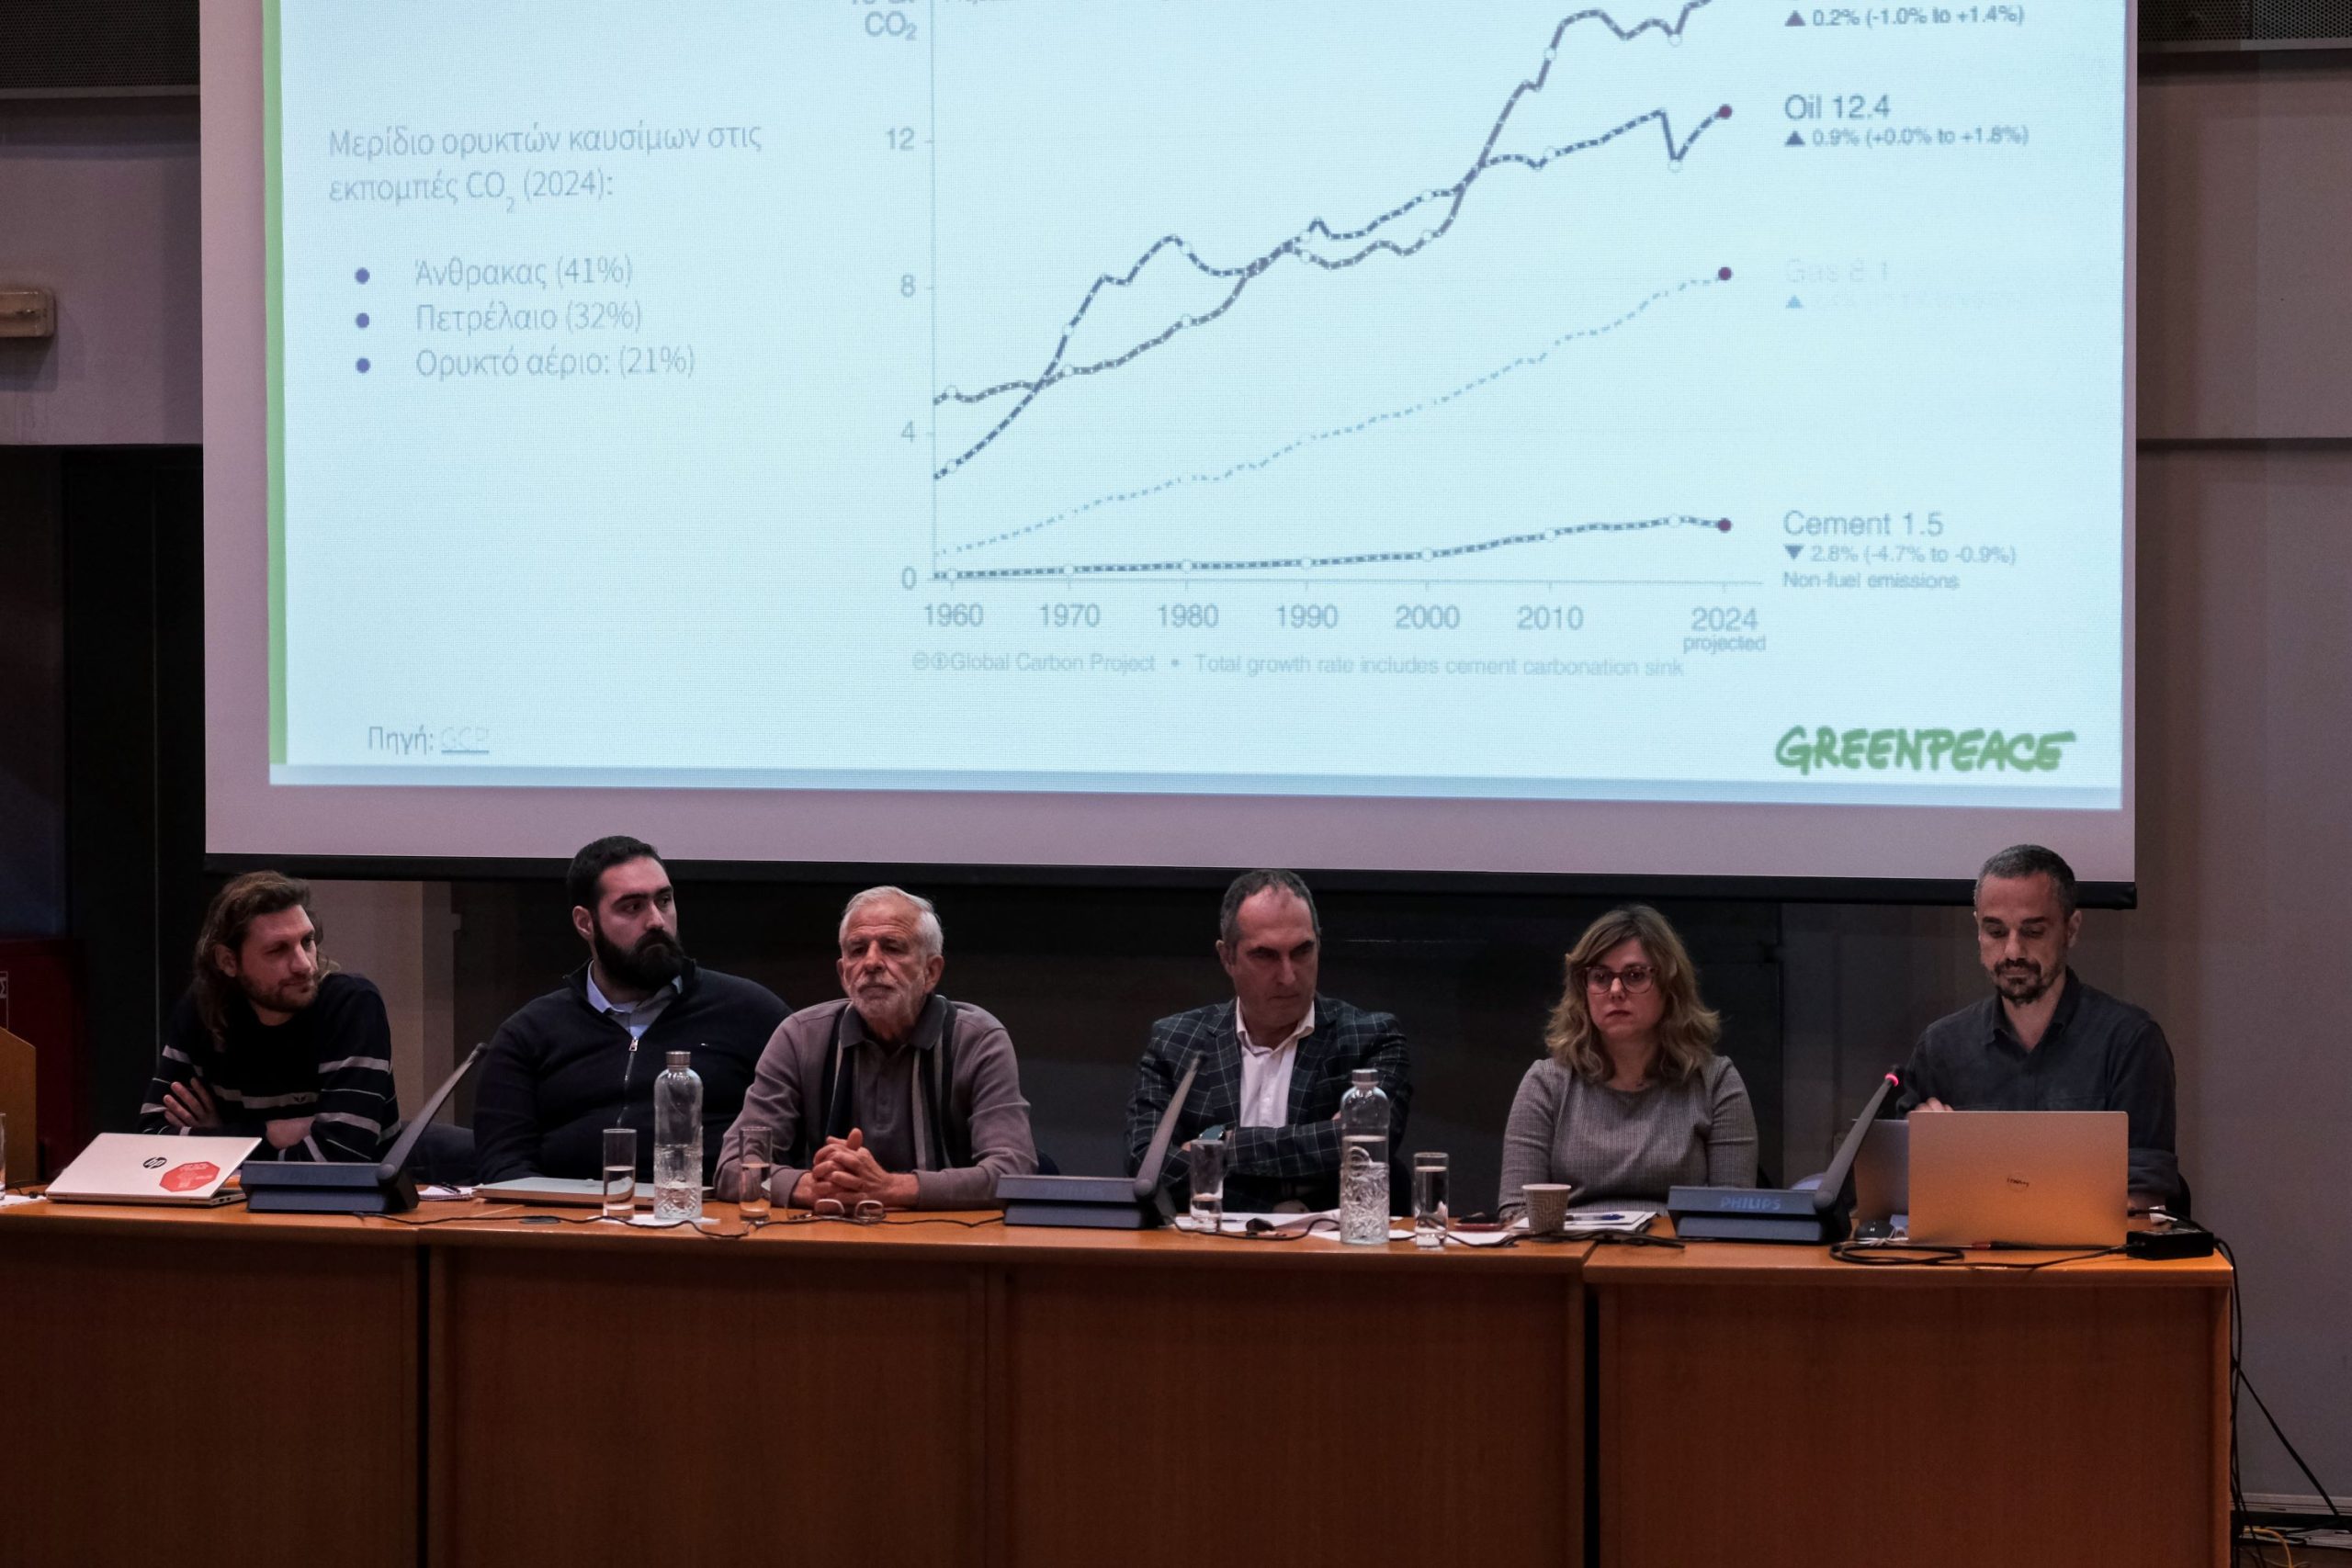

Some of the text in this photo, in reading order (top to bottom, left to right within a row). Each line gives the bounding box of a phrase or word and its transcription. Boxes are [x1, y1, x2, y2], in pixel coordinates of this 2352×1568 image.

[1813, 5, 2025, 28] 0.2% (-1.0% to +1.4%)
[1784, 94, 1891, 120] Oil 12.4
[329, 120, 763, 158] Μερίδιο ορυκτών καυσίμων στις
[886, 127, 915, 151] 12
[1866, 127, 1932, 148] (+0.0%
[1938, 127, 1955, 144] to
[329, 173, 458, 205] εκπομπές
[524, 169, 614, 203] (2024):
[415, 254, 633, 291] Άνθρακας (41%)
[900, 274, 916, 298] 8
[415, 300, 641, 336] Πετρέλαιο (32%)
[415, 344, 695, 381] Ορυκτό αέριο: (21%)
[900, 420, 916, 443] 4
[1783, 510, 1944, 537] Cement 1.5
[1810, 545, 1859, 563] 2.8%
[1863, 544, 1926, 566] (-4.7%
[1930, 545, 1948, 563] to
[900, 566, 917, 591] 0
[1782, 570, 1961, 591] Non-fuel emissions
[923, 603, 1758, 631] 1960 1970 1980 1990 2000 2010 2024
[1682, 633, 1767, 654] projected
[1015, 653, 1084, 671] Carbon
[1090, 653, 1156, 676] Project
[1194, 655, 1241, 673] Total
[1247, 654, 1310, 677] growth
[1317, 657, 1353, 674] rate
[1361, 656, 1440, 675] includes
[1445, 658, 1517, 676] cement
[1523, 657, 1639, 677] carbonation
[1645, 658, 1685, 677] sink
[368, 724, 434, 755] Πηγή:
[1774, 725, 2076, 775] GREENPEACE
[1720, 1196, 1781, 1211] PHILIPS
